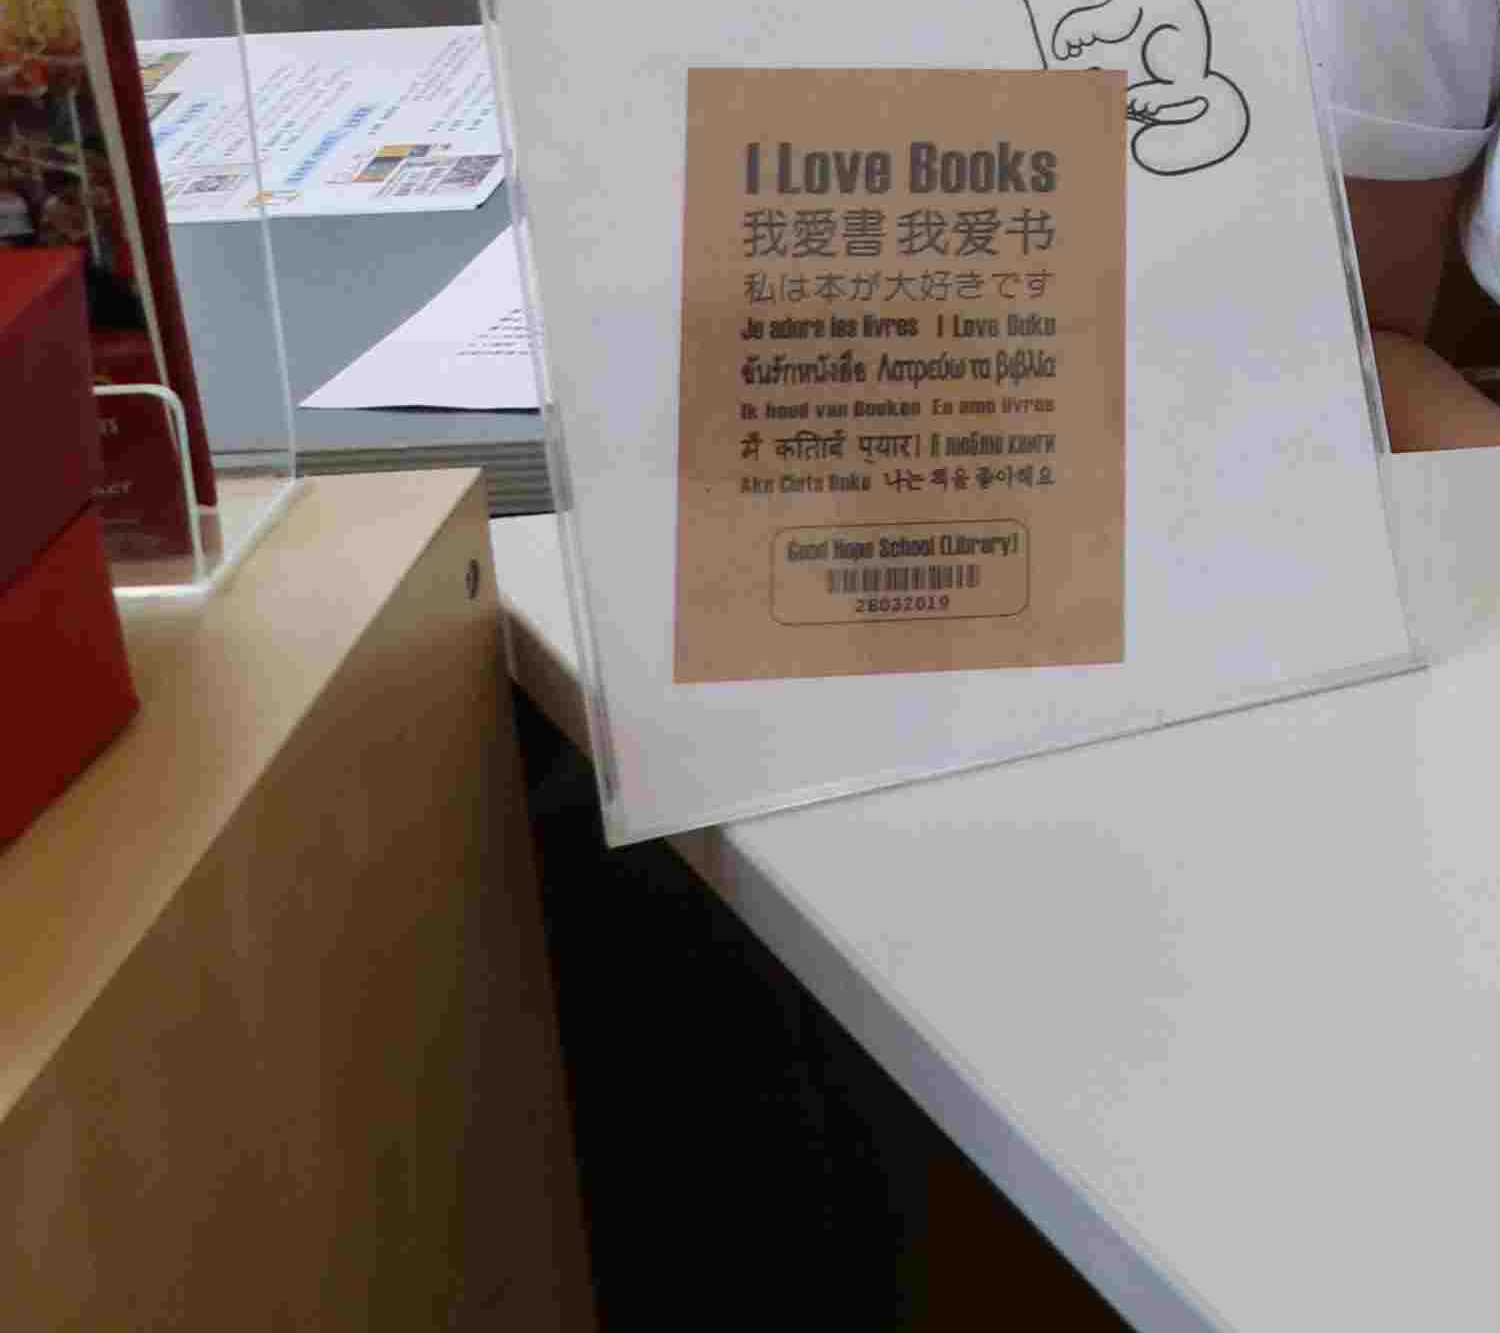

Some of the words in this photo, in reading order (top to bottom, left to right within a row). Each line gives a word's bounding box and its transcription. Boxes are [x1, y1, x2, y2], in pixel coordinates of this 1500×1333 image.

[745, 142, 760, 195] I
[776, 141, 890, 194] Love
[909, 141, 1056, 193] Books
